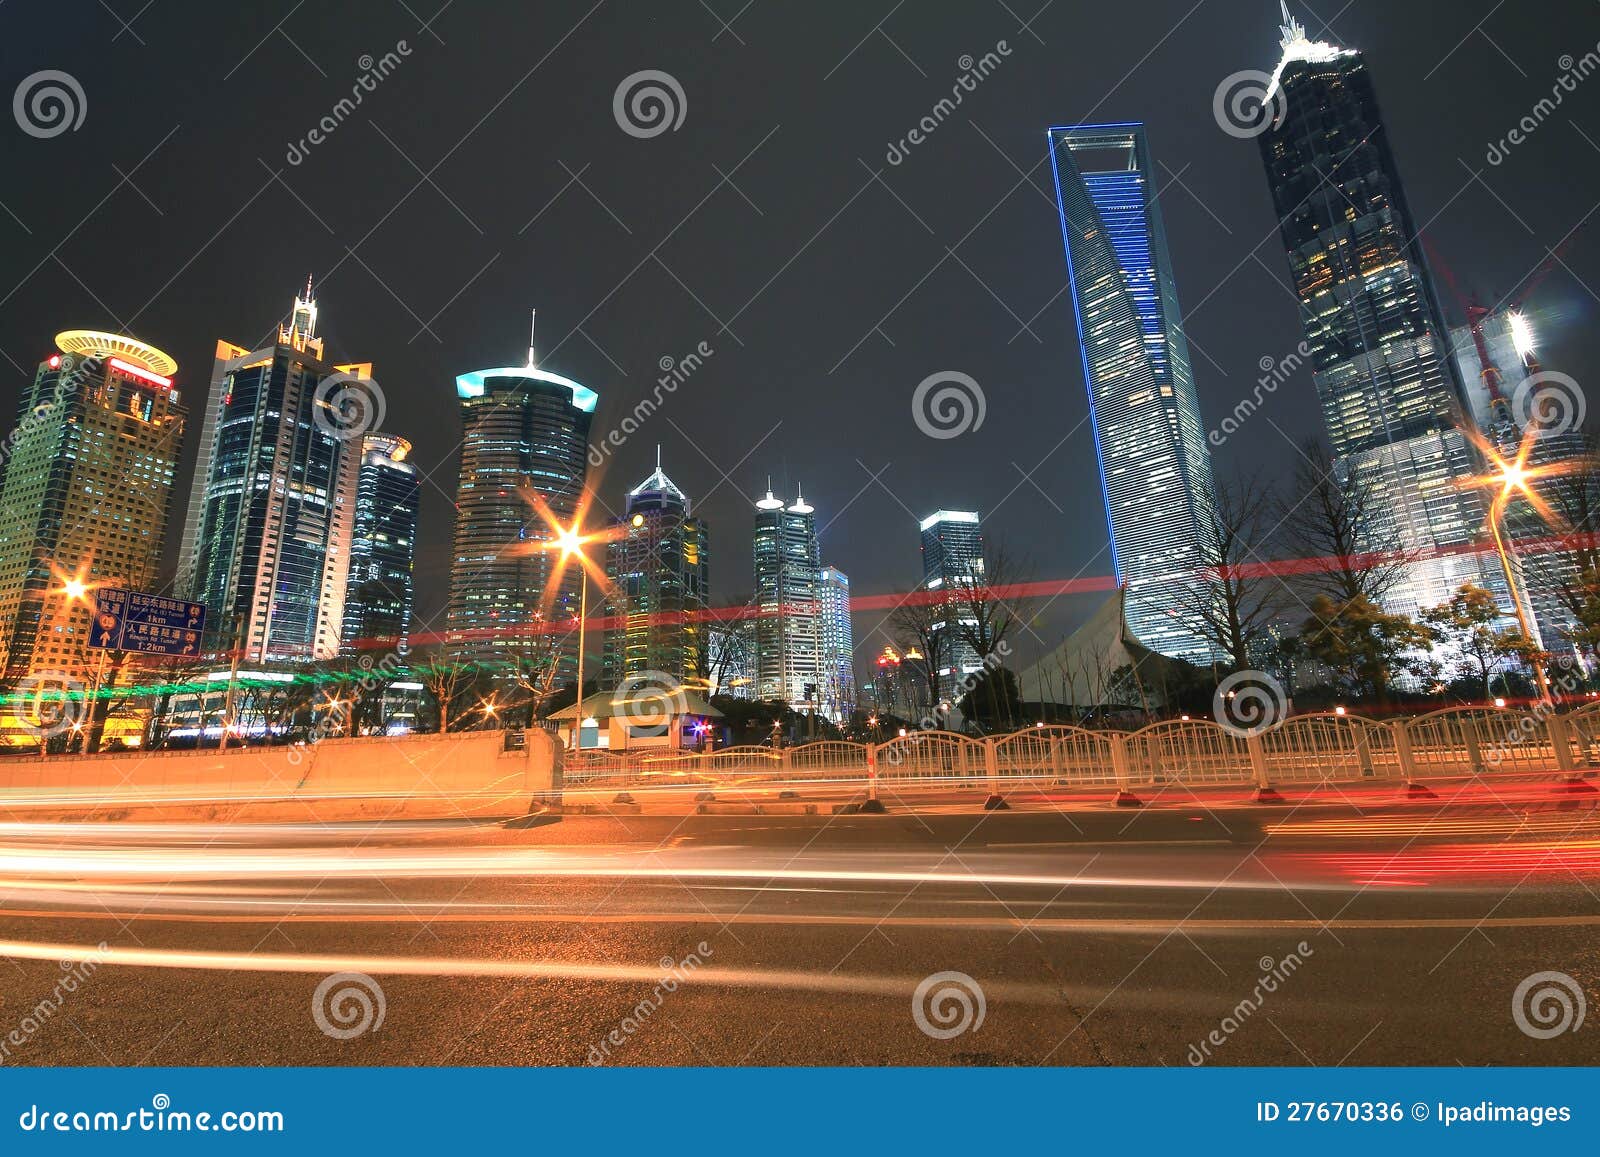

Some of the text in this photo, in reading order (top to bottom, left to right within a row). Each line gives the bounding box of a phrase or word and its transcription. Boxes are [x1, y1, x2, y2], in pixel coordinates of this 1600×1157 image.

[147, 614, 166, 624] 1km
[127, 623, 181, 639] 人民路隧道
[138, 641, 166, 652] 1.2km
